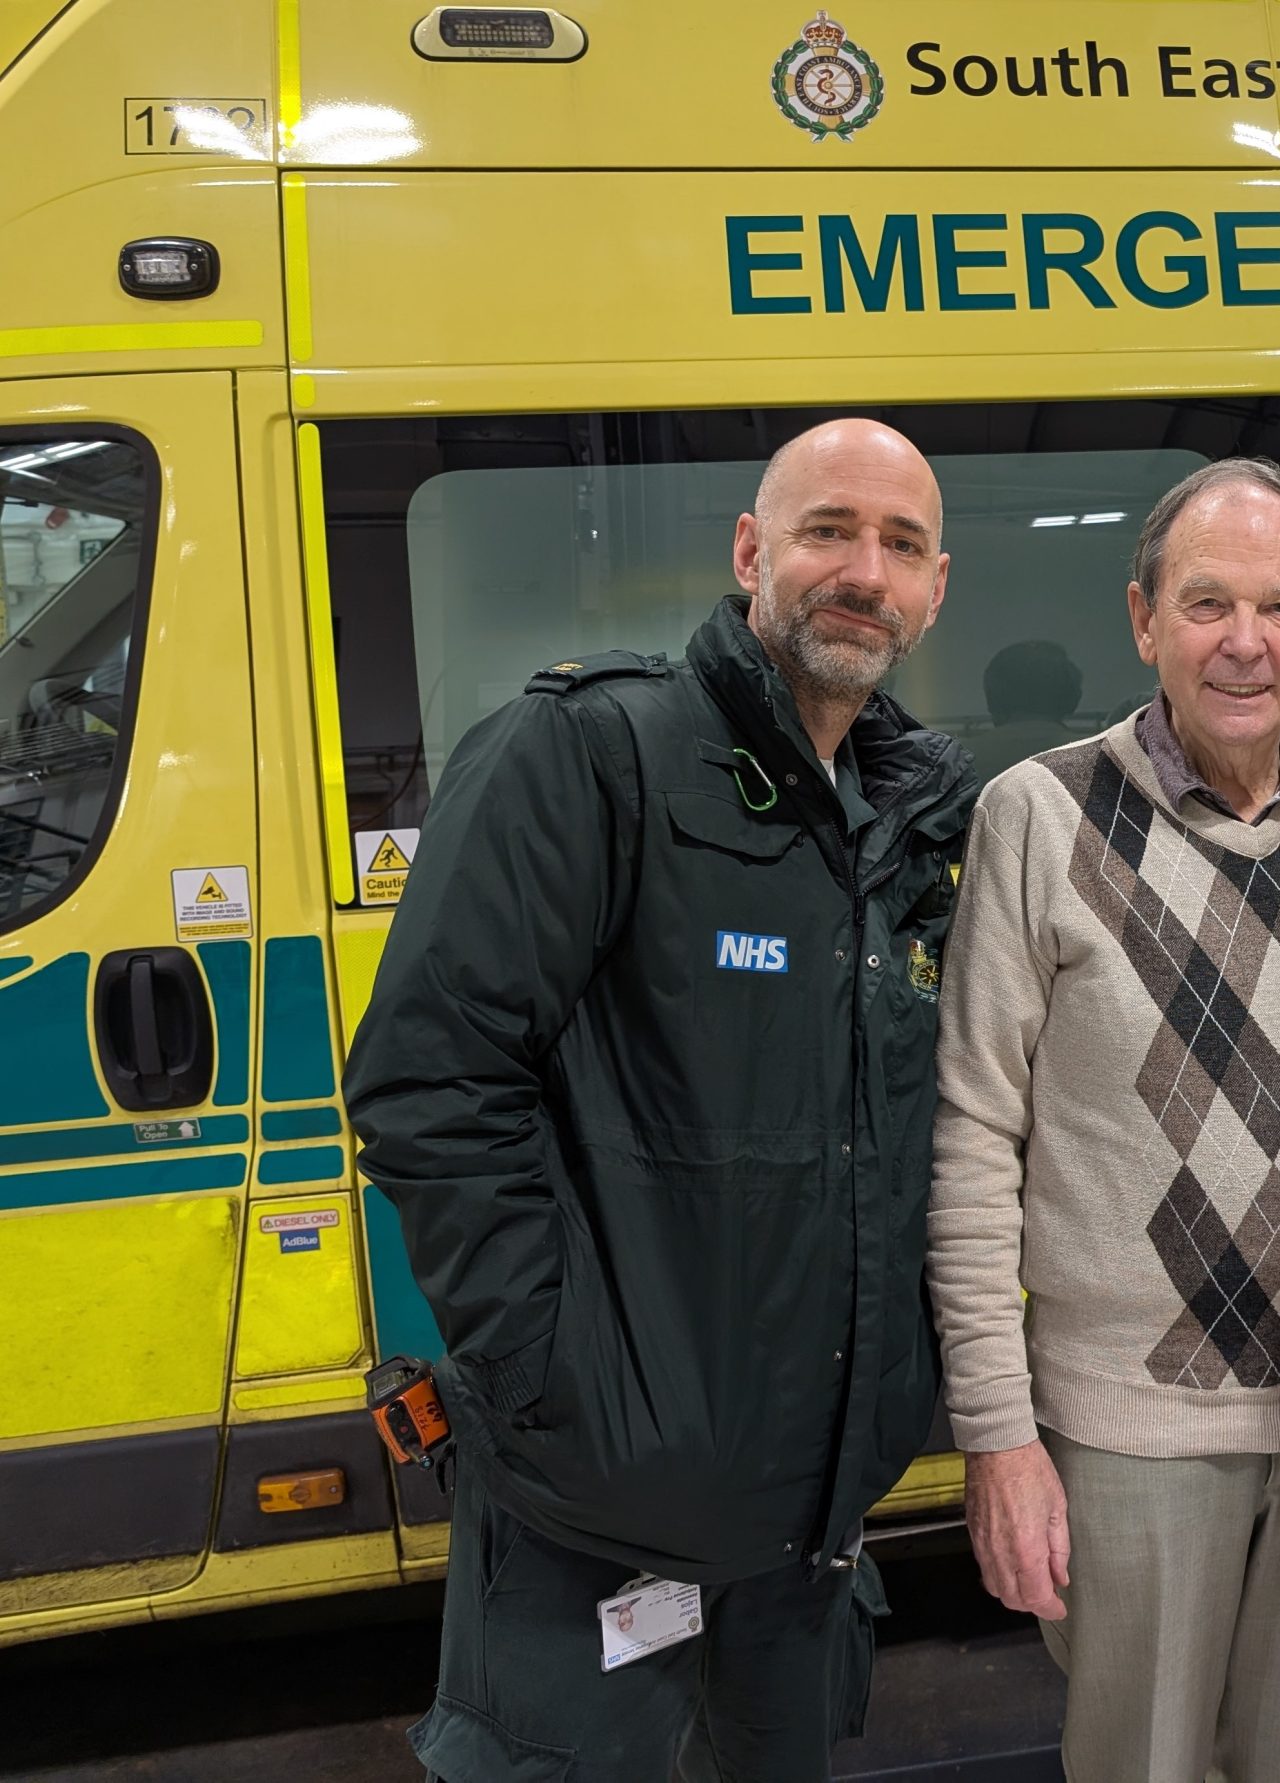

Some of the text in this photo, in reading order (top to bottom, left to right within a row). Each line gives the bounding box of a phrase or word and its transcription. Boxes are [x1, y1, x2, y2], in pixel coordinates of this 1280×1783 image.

[905, 40, 1129, 98] South
[367, 890, 400, 899] Mind the
[719, 934, 787, 970] NHS
[139, 1124, 156, 1132] Pull
[143, 1131, 168, 1140] Open
[274, 1213, 337, 1228] DIESEL ONLY
[282, 1235, 318, 1248] AdBlue
